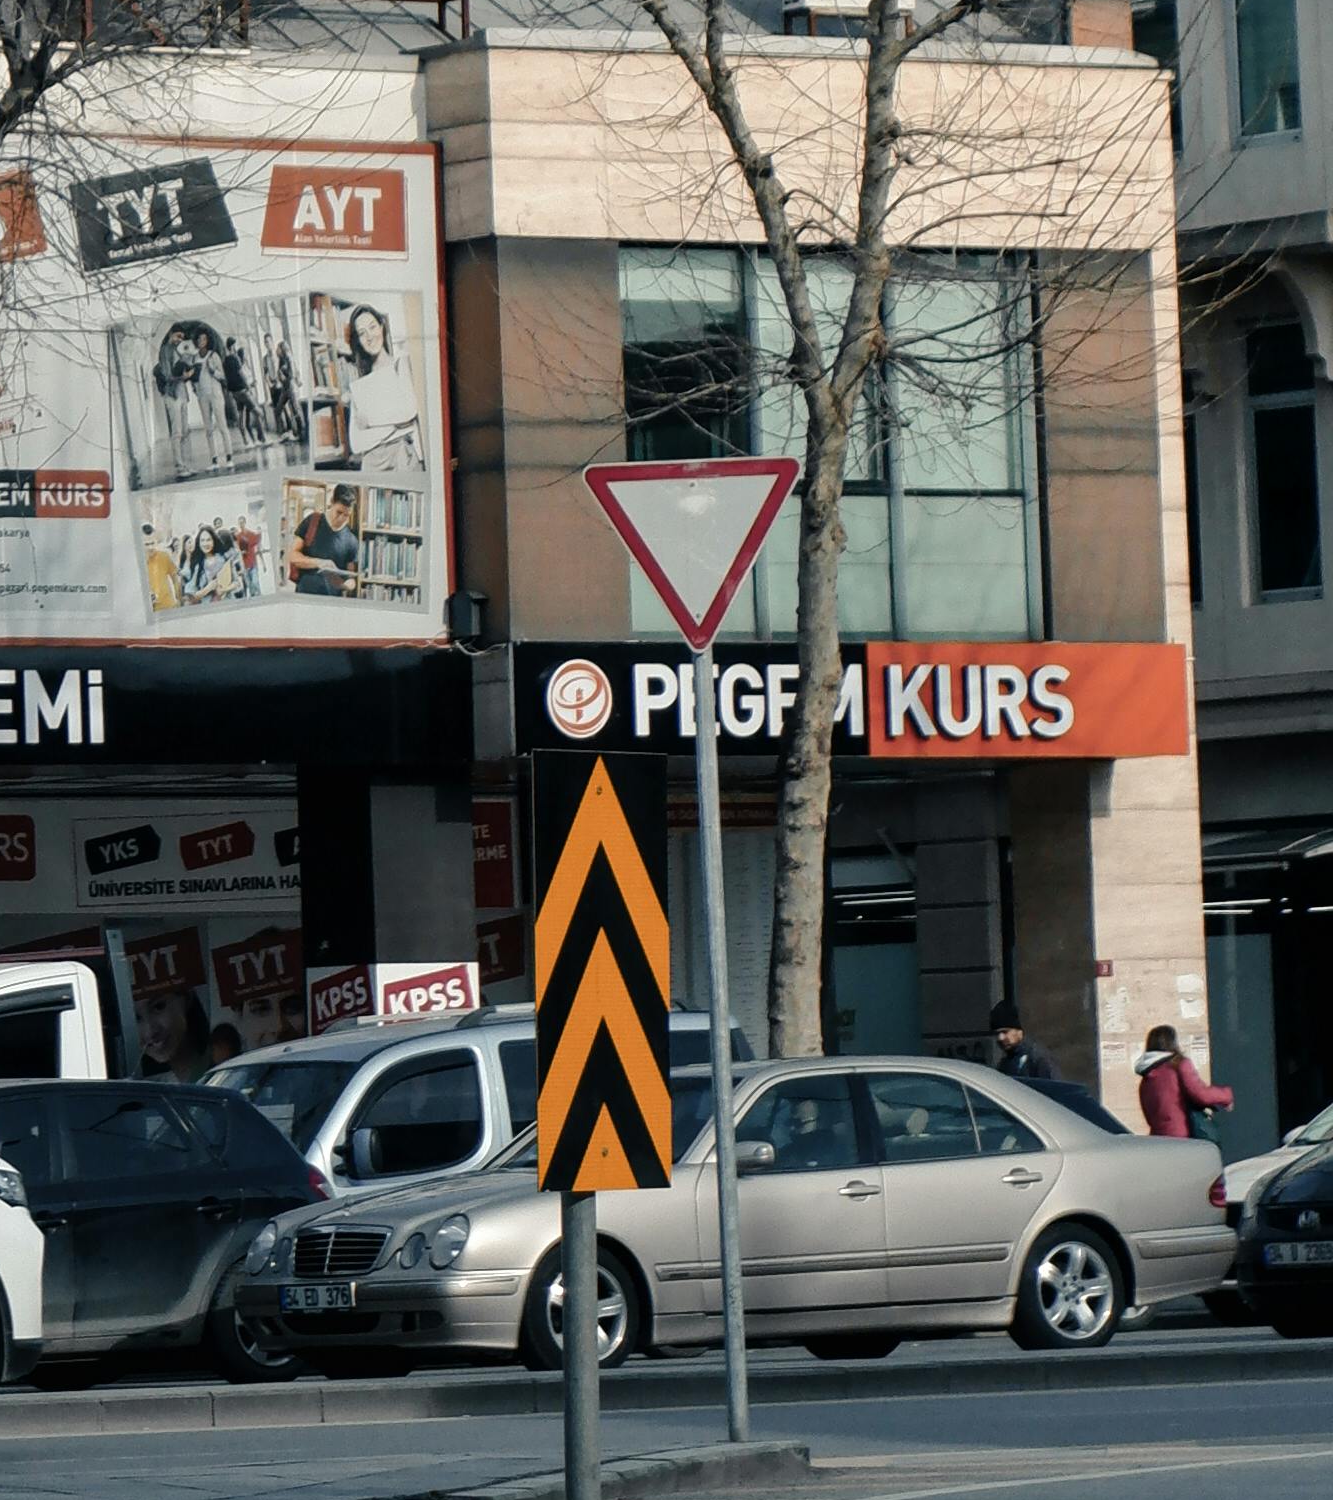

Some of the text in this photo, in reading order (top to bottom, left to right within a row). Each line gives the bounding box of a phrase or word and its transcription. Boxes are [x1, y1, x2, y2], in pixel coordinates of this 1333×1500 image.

[97, 178, 183, 241] TYT
[293, 184, 382, 232] AYT
[40, 482, 104, 506] KURS
[888, 663, 1074, 739] KURS
[99, 838, 140, 864] YKS
[197, 833, 234, 860] TYT
[89, 875, 301, 897] ÜNİVERSİTE SINAVLARINA HA
[229, 944, 287, 986] TYT
[314, 976, 368, 1022] KPSS
[388, 977, 466, 1015] KPSS
[326, 1287, 350, 1306] 376
